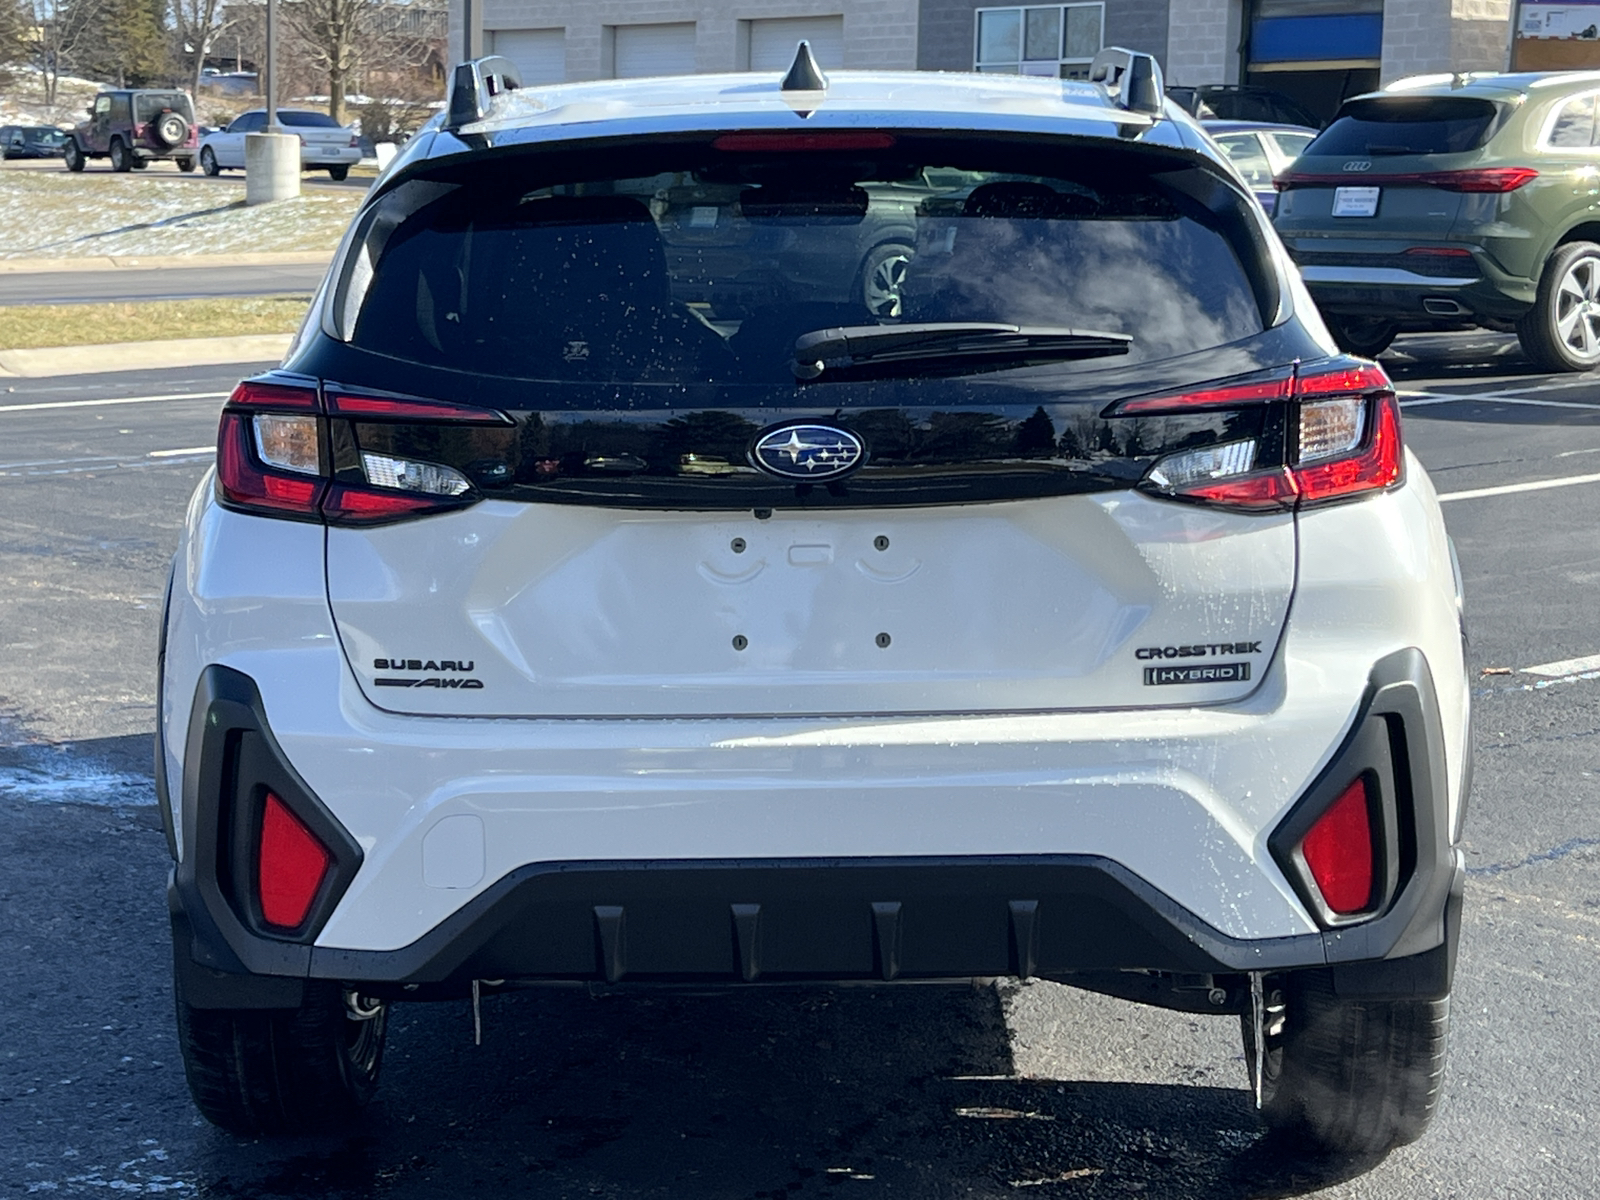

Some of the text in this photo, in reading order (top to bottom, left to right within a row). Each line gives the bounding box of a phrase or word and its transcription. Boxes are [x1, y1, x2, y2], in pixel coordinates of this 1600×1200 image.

[1135, 641, 1262, 660] CROSSTREK
[374, 658, 474, 671] SUBARU
[1161, 668, 1234, 680] HYBRID
[414, 678, 484, 689] AWD
